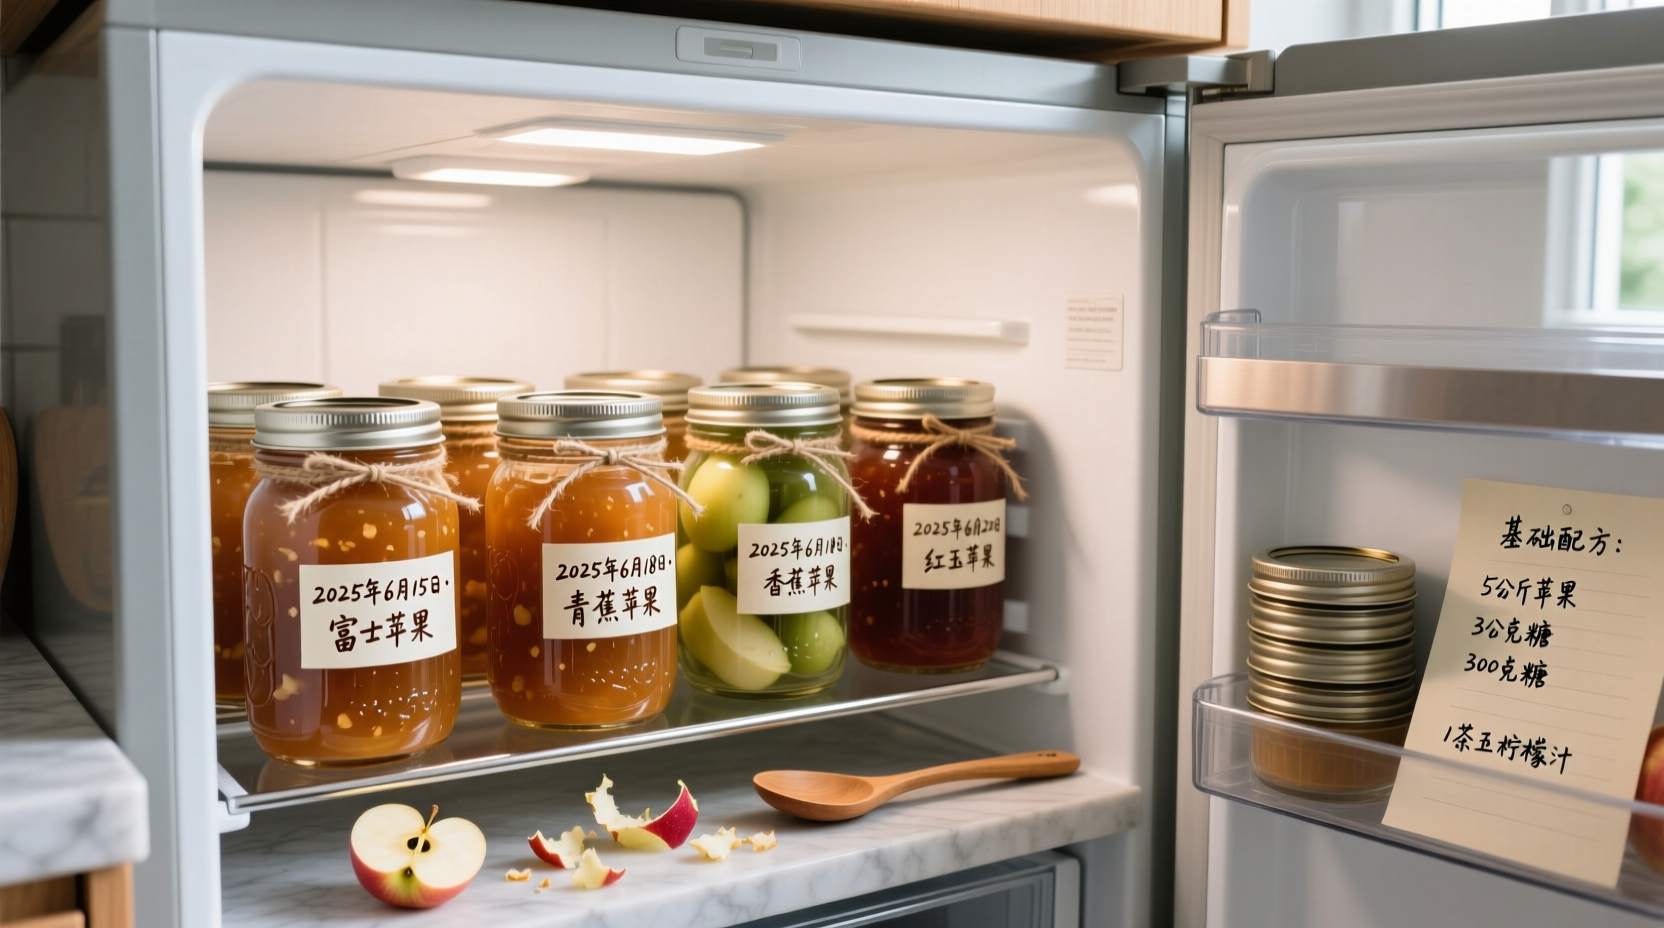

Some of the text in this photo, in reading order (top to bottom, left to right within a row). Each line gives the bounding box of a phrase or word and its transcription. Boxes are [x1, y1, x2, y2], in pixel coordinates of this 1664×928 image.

[924, 544, 995, 573] 红玉苹果
[764, 565, 837, 597] 香蕉苹果
[564, 586, 660, 628] 青蕉苹果
[329, 609, 433, 652] 富士苹果
[1471, 617, 1553, 648] 3公克糖
[1464, 653, 1549, 688] 300克糖
[1444, 724, 1572, 775] 1茶五柠檬汁
